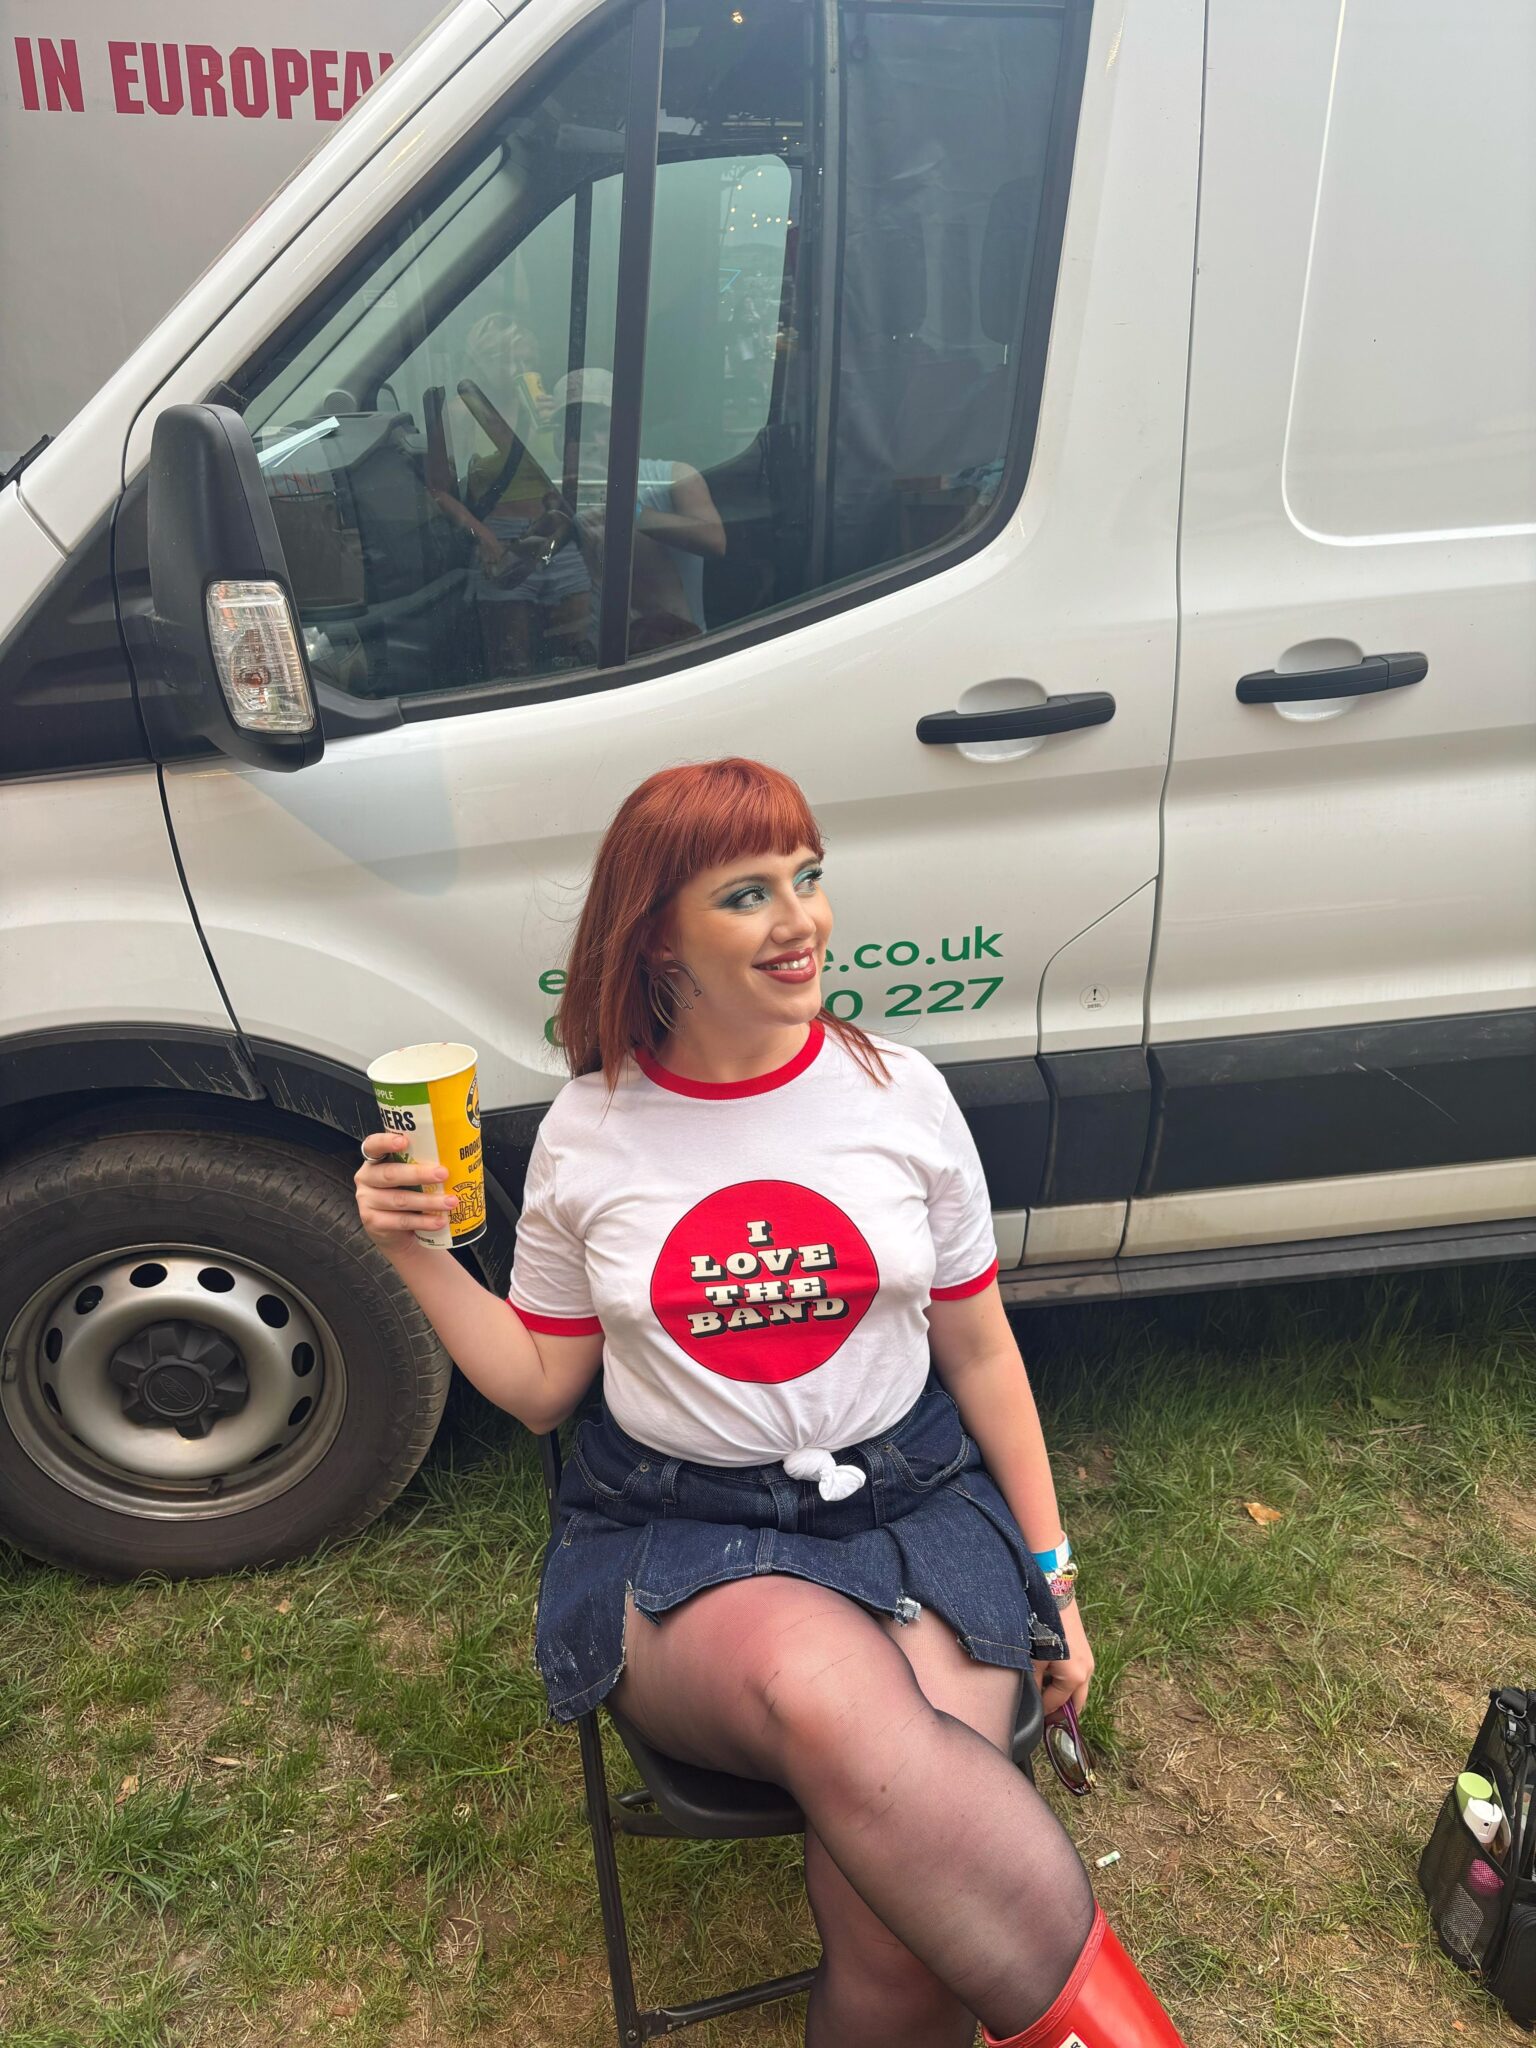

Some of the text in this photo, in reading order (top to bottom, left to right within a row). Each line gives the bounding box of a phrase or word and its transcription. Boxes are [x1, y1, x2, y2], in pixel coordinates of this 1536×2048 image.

[14, 37, 394, 121] IN EUROPEA
[885, 976, 1004, 1017] 227
[747, 1221, 773, 1246] I
[690, 1243, 837, 1282] LOVE
[705, 1276, 827, 1307] THE
[688, 1298, 849, 1338] BAND
